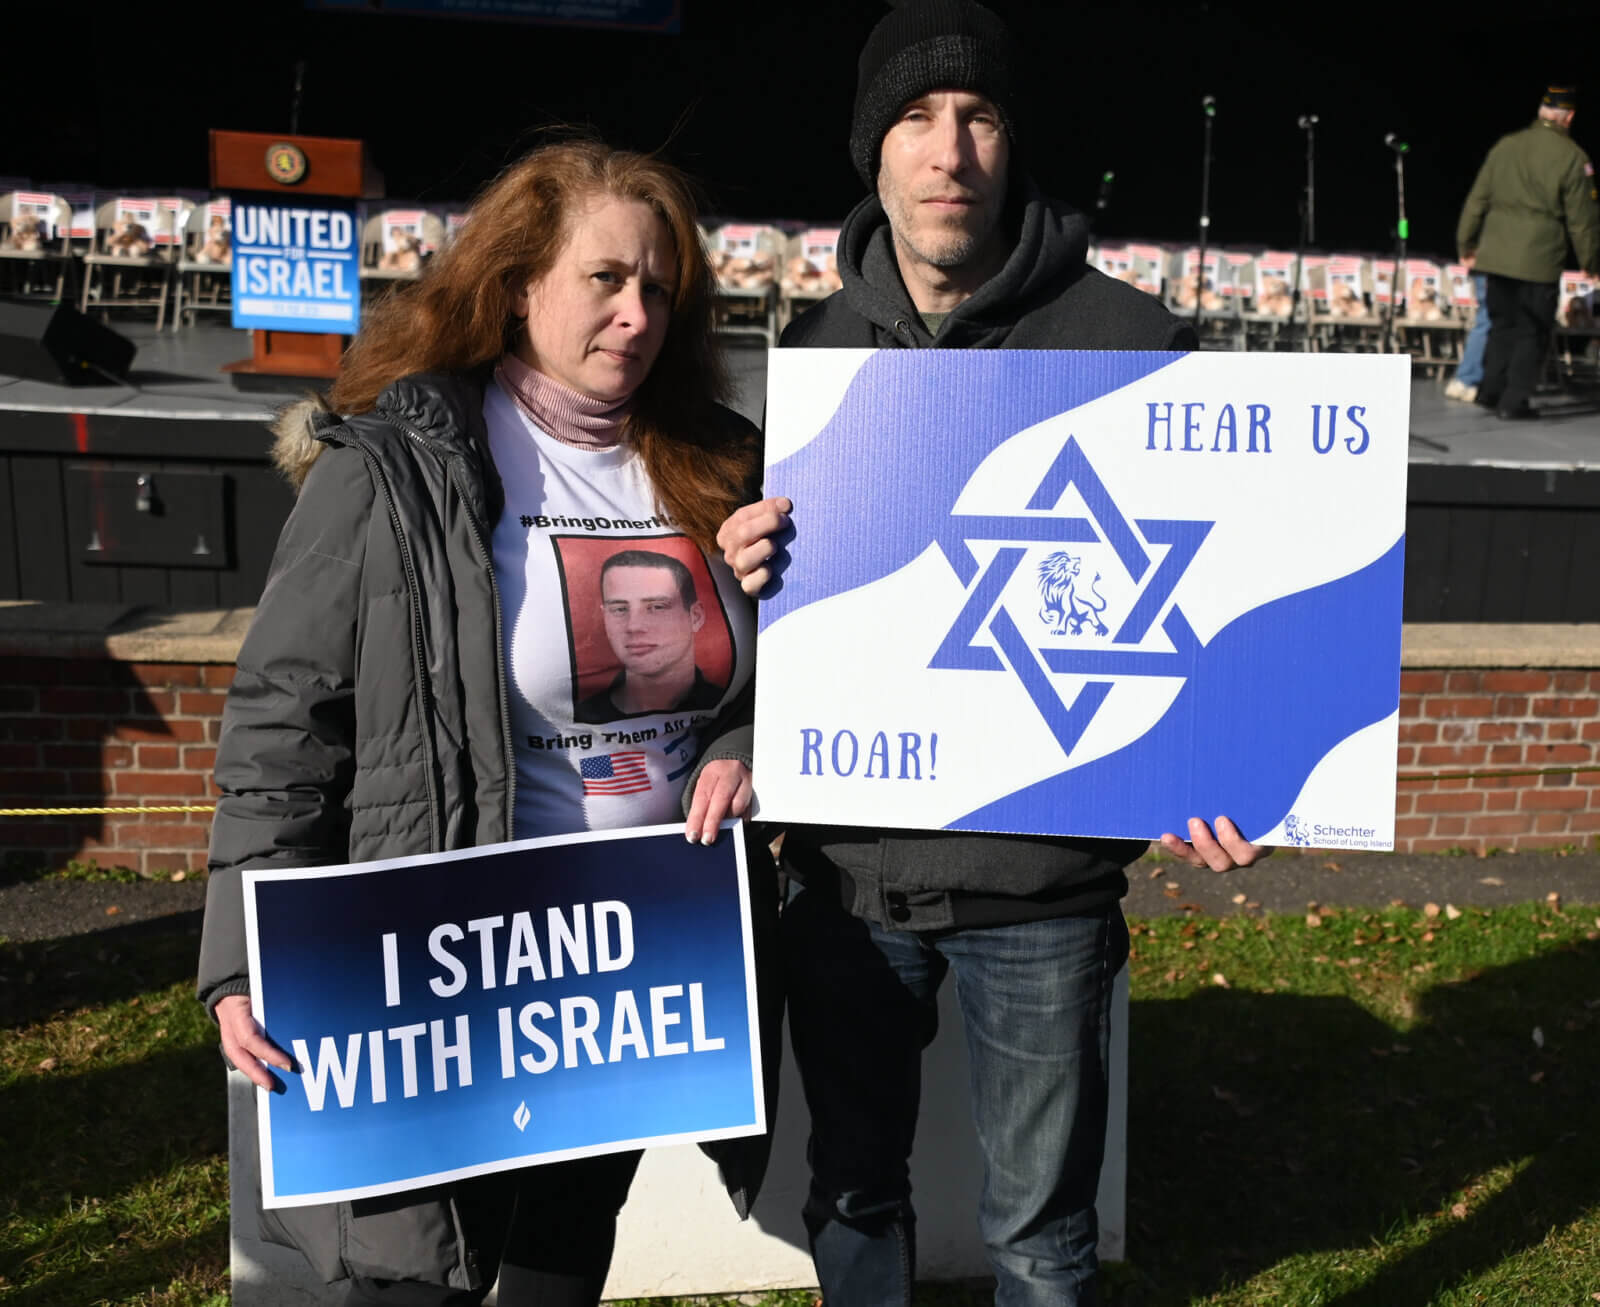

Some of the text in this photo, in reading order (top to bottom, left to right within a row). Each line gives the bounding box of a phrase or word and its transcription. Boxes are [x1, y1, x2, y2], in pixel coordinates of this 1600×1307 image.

[235, 206, 352, 249] UNITED
[238, 257, 352, 299] ISRAEL
[1145, 402, 1370, 455] HEAR US
[527, 734, 593, 751] Bring
[601, 728, 657, 745] Them
[799, 728, 938, 780] ROAR!
[1313, 824, 1376, 838] Schechter
[1313, 836, 1339, 846] School
[1340, 838, 1349, 846] of
[1349, 839, 1369, 849] Long
[382, 900, 635, 1007] I STAND
[291, 982, 726, 1112] WITH ISRAEL
